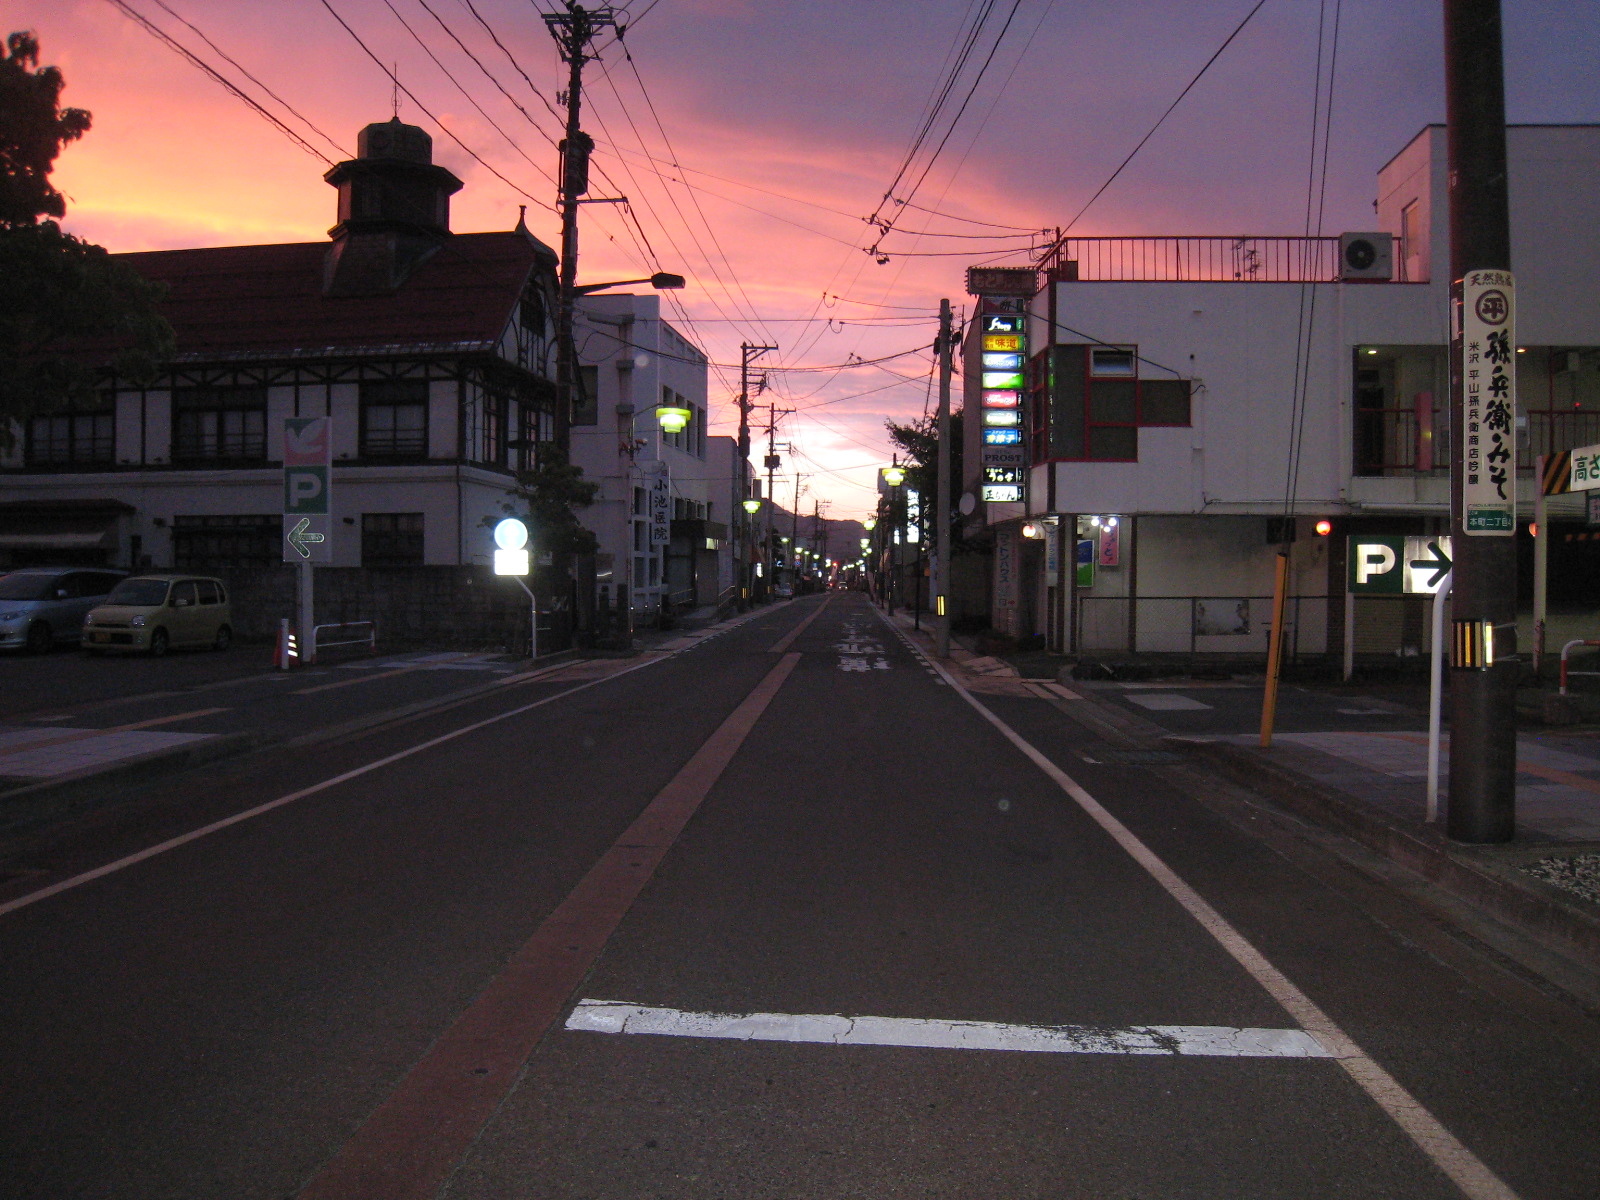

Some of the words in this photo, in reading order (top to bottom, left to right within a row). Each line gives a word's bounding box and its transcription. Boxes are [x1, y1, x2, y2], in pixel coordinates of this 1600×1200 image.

[1482, 297, 1504, 320] 平
[995, 338, 1017, 349] 味道
[1468, 341, 1480, 364] 米沢
[1483, 328, 1511, 500] 孫兵衛みそ
[984, 454, 1022, 462] PROST
[290, 473, 322, 507] P
[985, 489, 1016, 500] 正ちん
[654, 479, 668, 541] 小池医院
[1357, 544, 1396, 584] P
